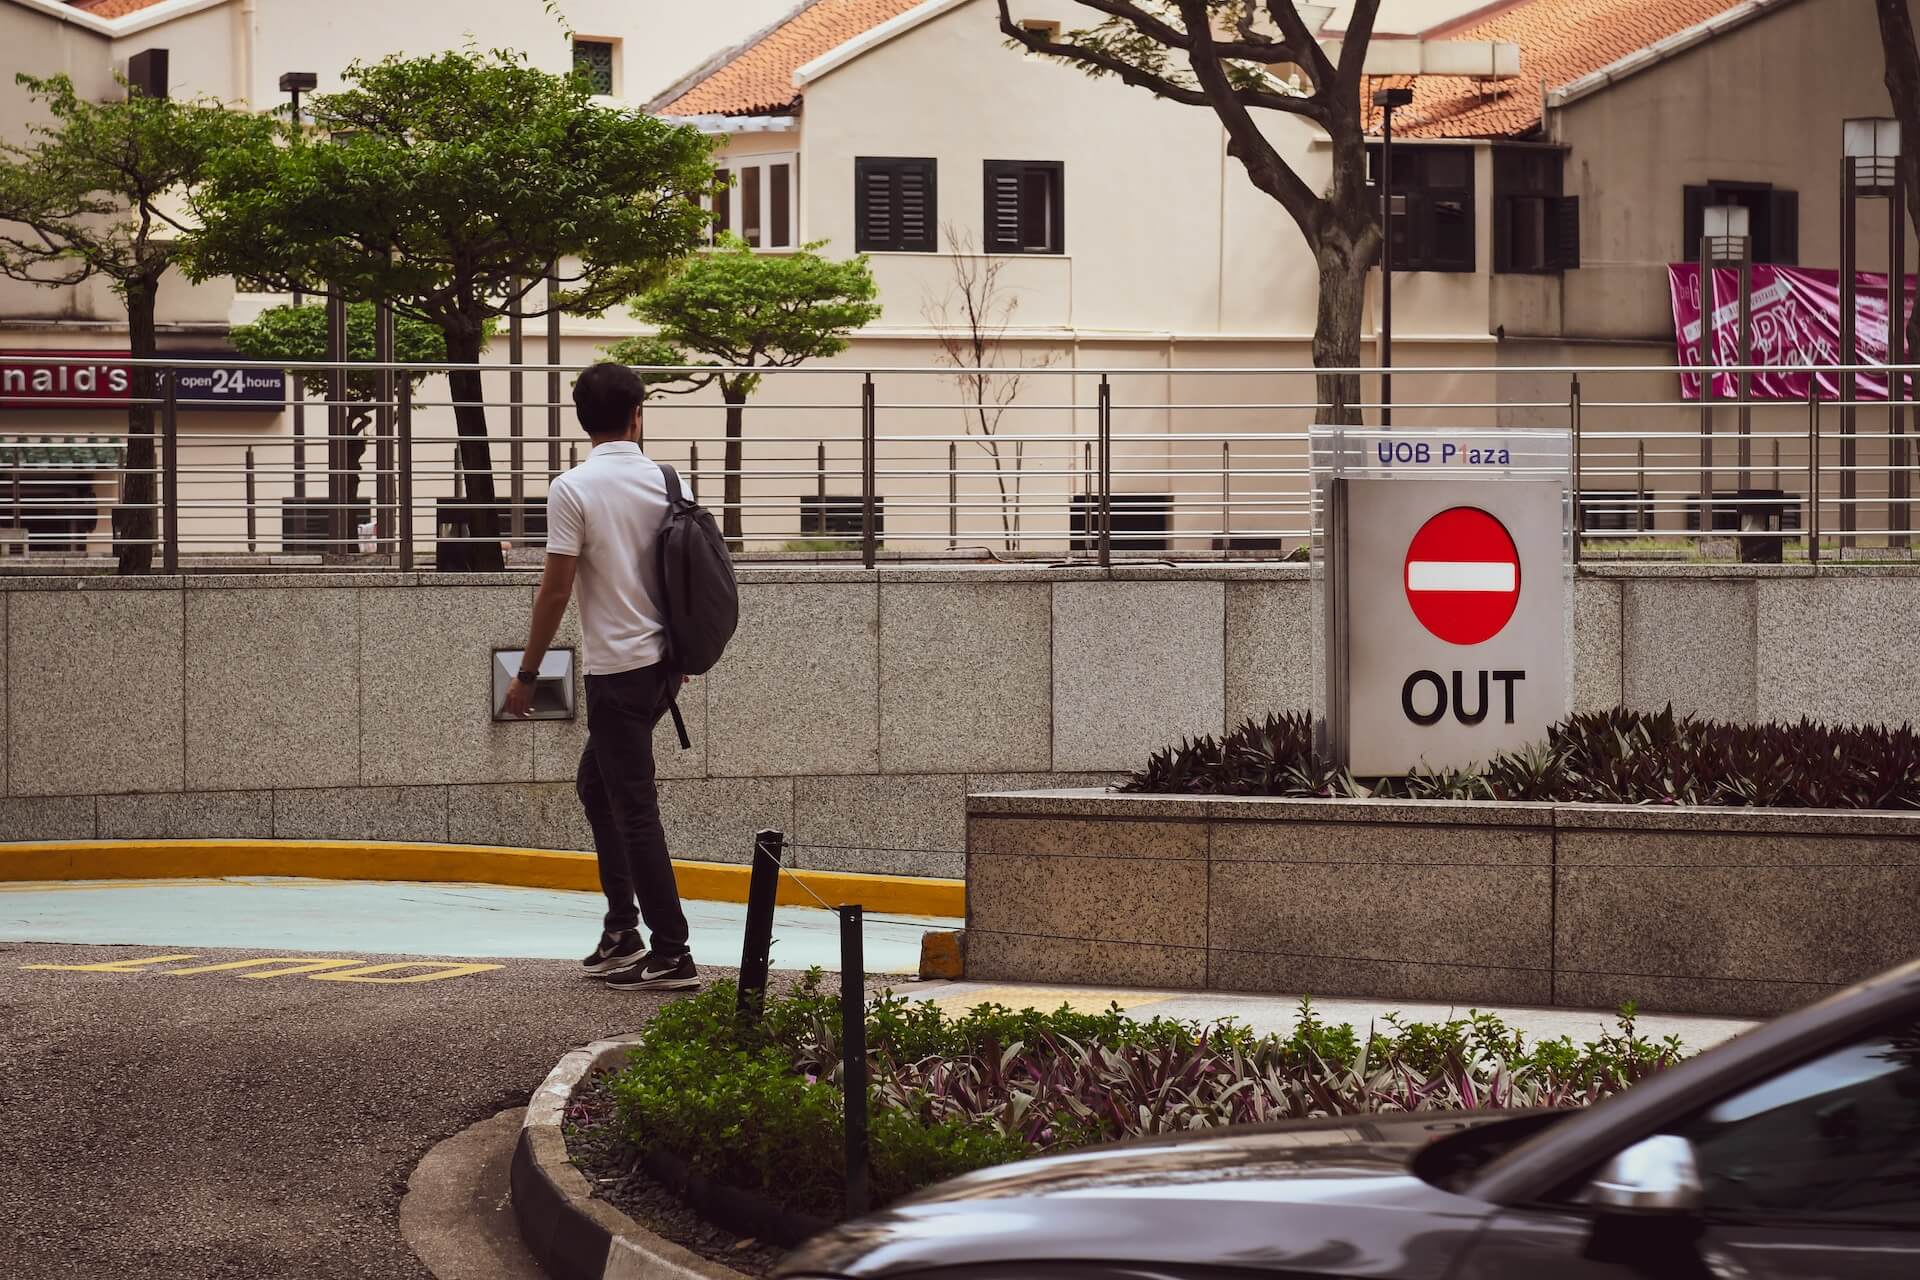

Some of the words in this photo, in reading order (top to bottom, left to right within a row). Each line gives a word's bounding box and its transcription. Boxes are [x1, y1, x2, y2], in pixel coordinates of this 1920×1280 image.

[3, 366, 129, 392] nald's
[181, 376, 212, 388] open
[212, 369, 246, 393] 24
[246, 376, 282, 388] hours
[1378, 442, 1431, 463] UOB
[1401, 669, 1526, 727] OUT
